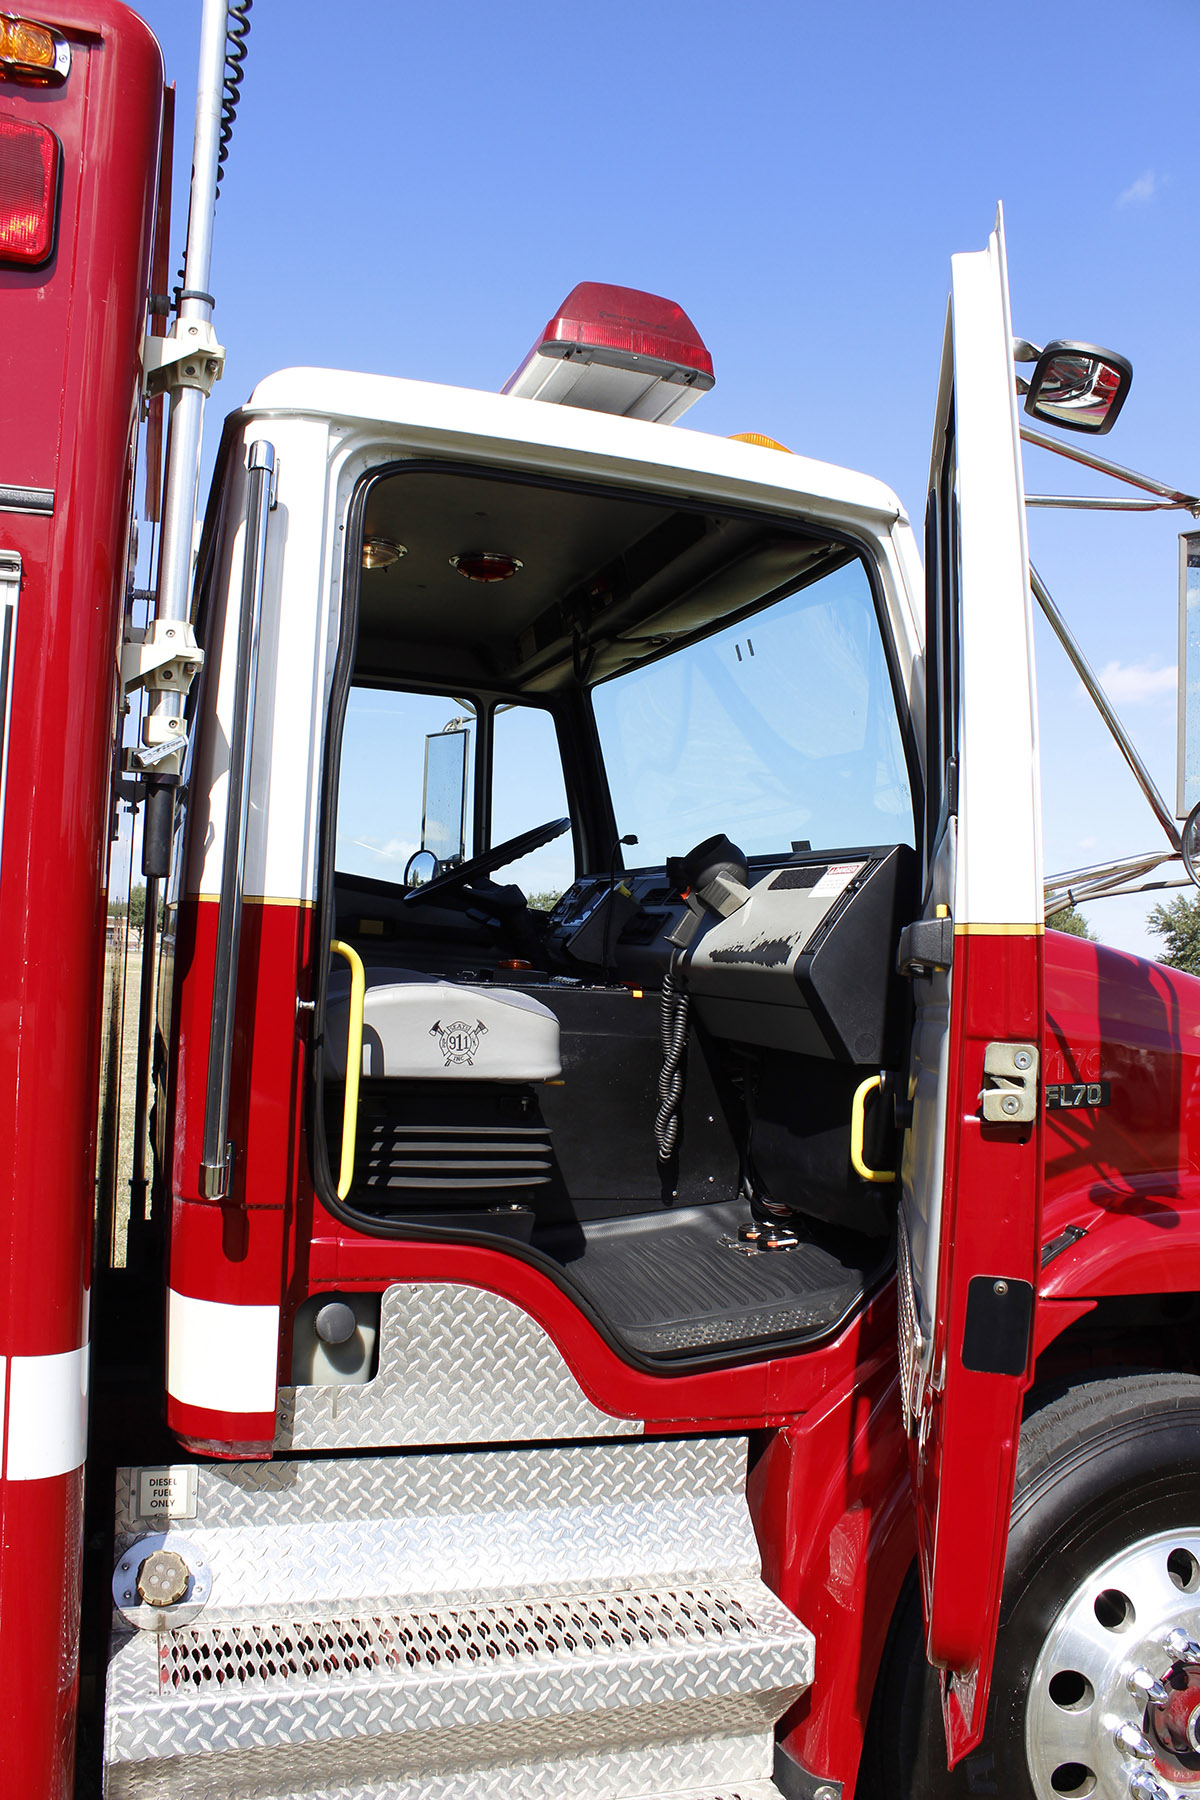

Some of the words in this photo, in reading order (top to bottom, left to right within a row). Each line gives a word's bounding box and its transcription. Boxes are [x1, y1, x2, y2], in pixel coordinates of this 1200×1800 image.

[449, 1034, 470, 1052] 911
[1044, 1084, 1102, 1107] FL70
[149, 1478, 177, 1487] DIESEL
[153, 1488, 173, 1497] FUEL
[150, 1499, 176, 1508] ONLY
